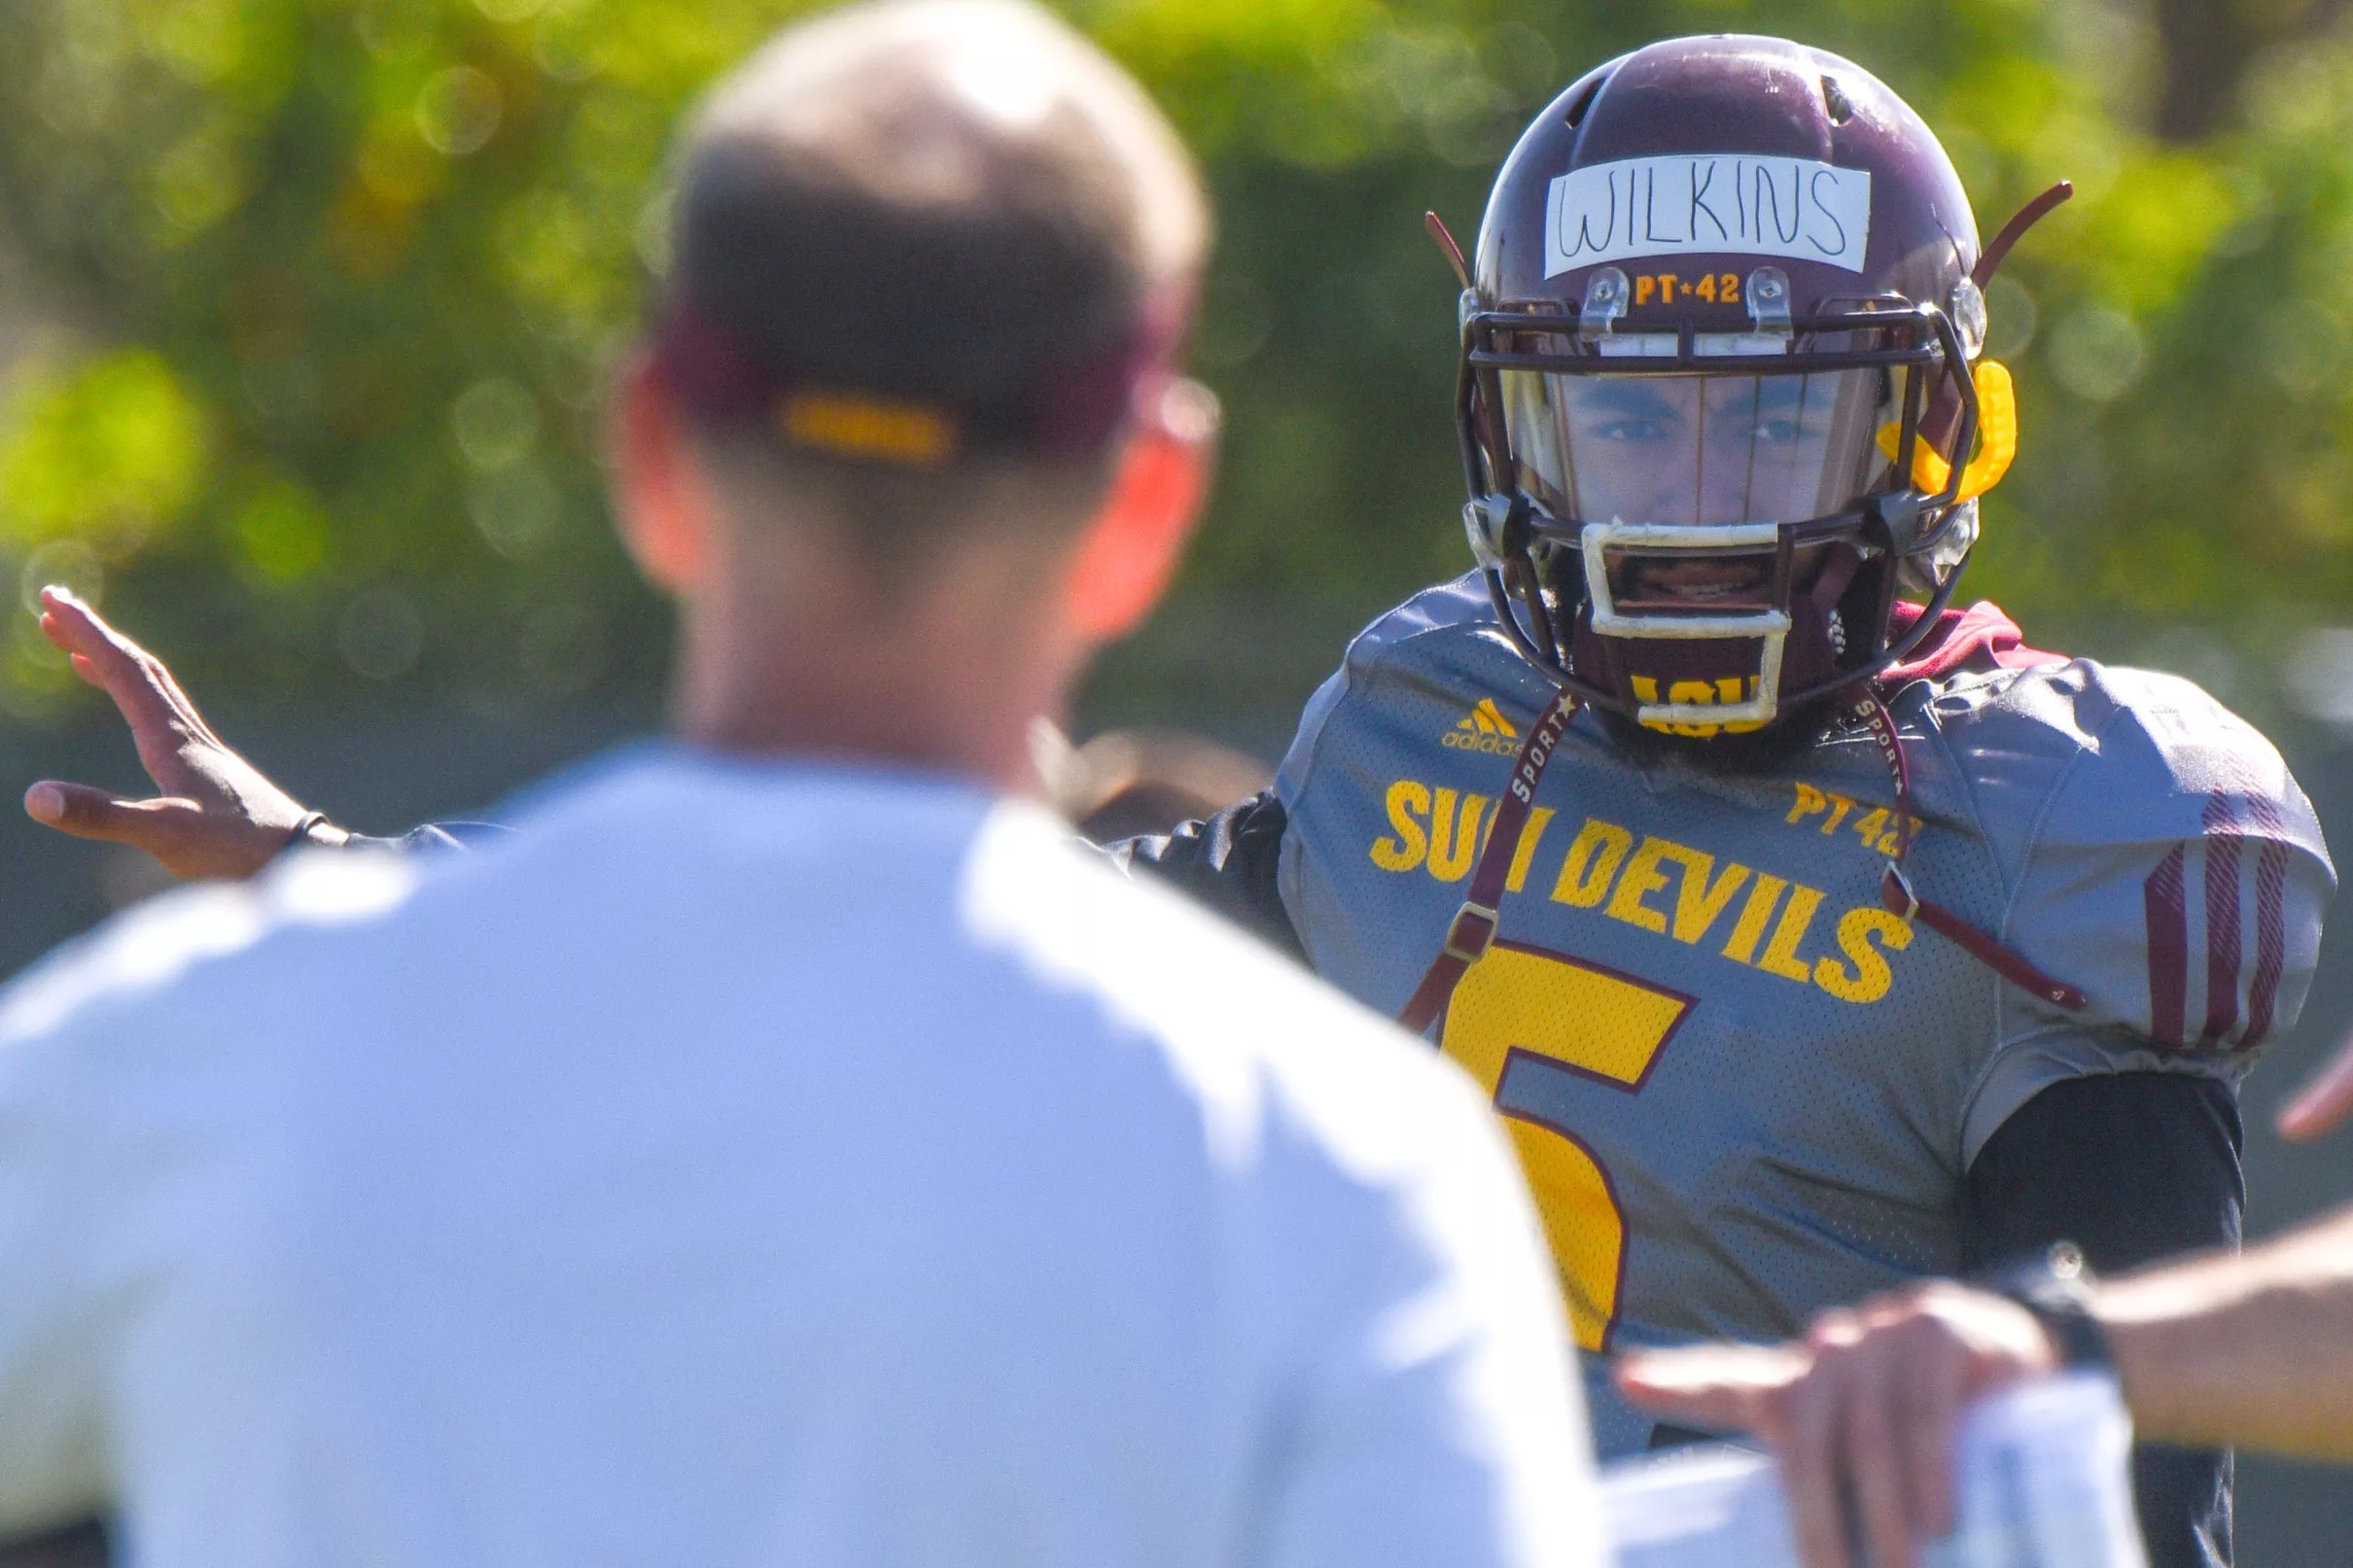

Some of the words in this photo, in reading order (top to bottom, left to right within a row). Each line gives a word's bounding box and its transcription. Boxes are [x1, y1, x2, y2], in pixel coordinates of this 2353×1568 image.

[1558, 159, 1845, 258] WILKINS
[1511, 714, 1563, 803] SPORT
[1549, 818, 1914, 1004] DEVILS
